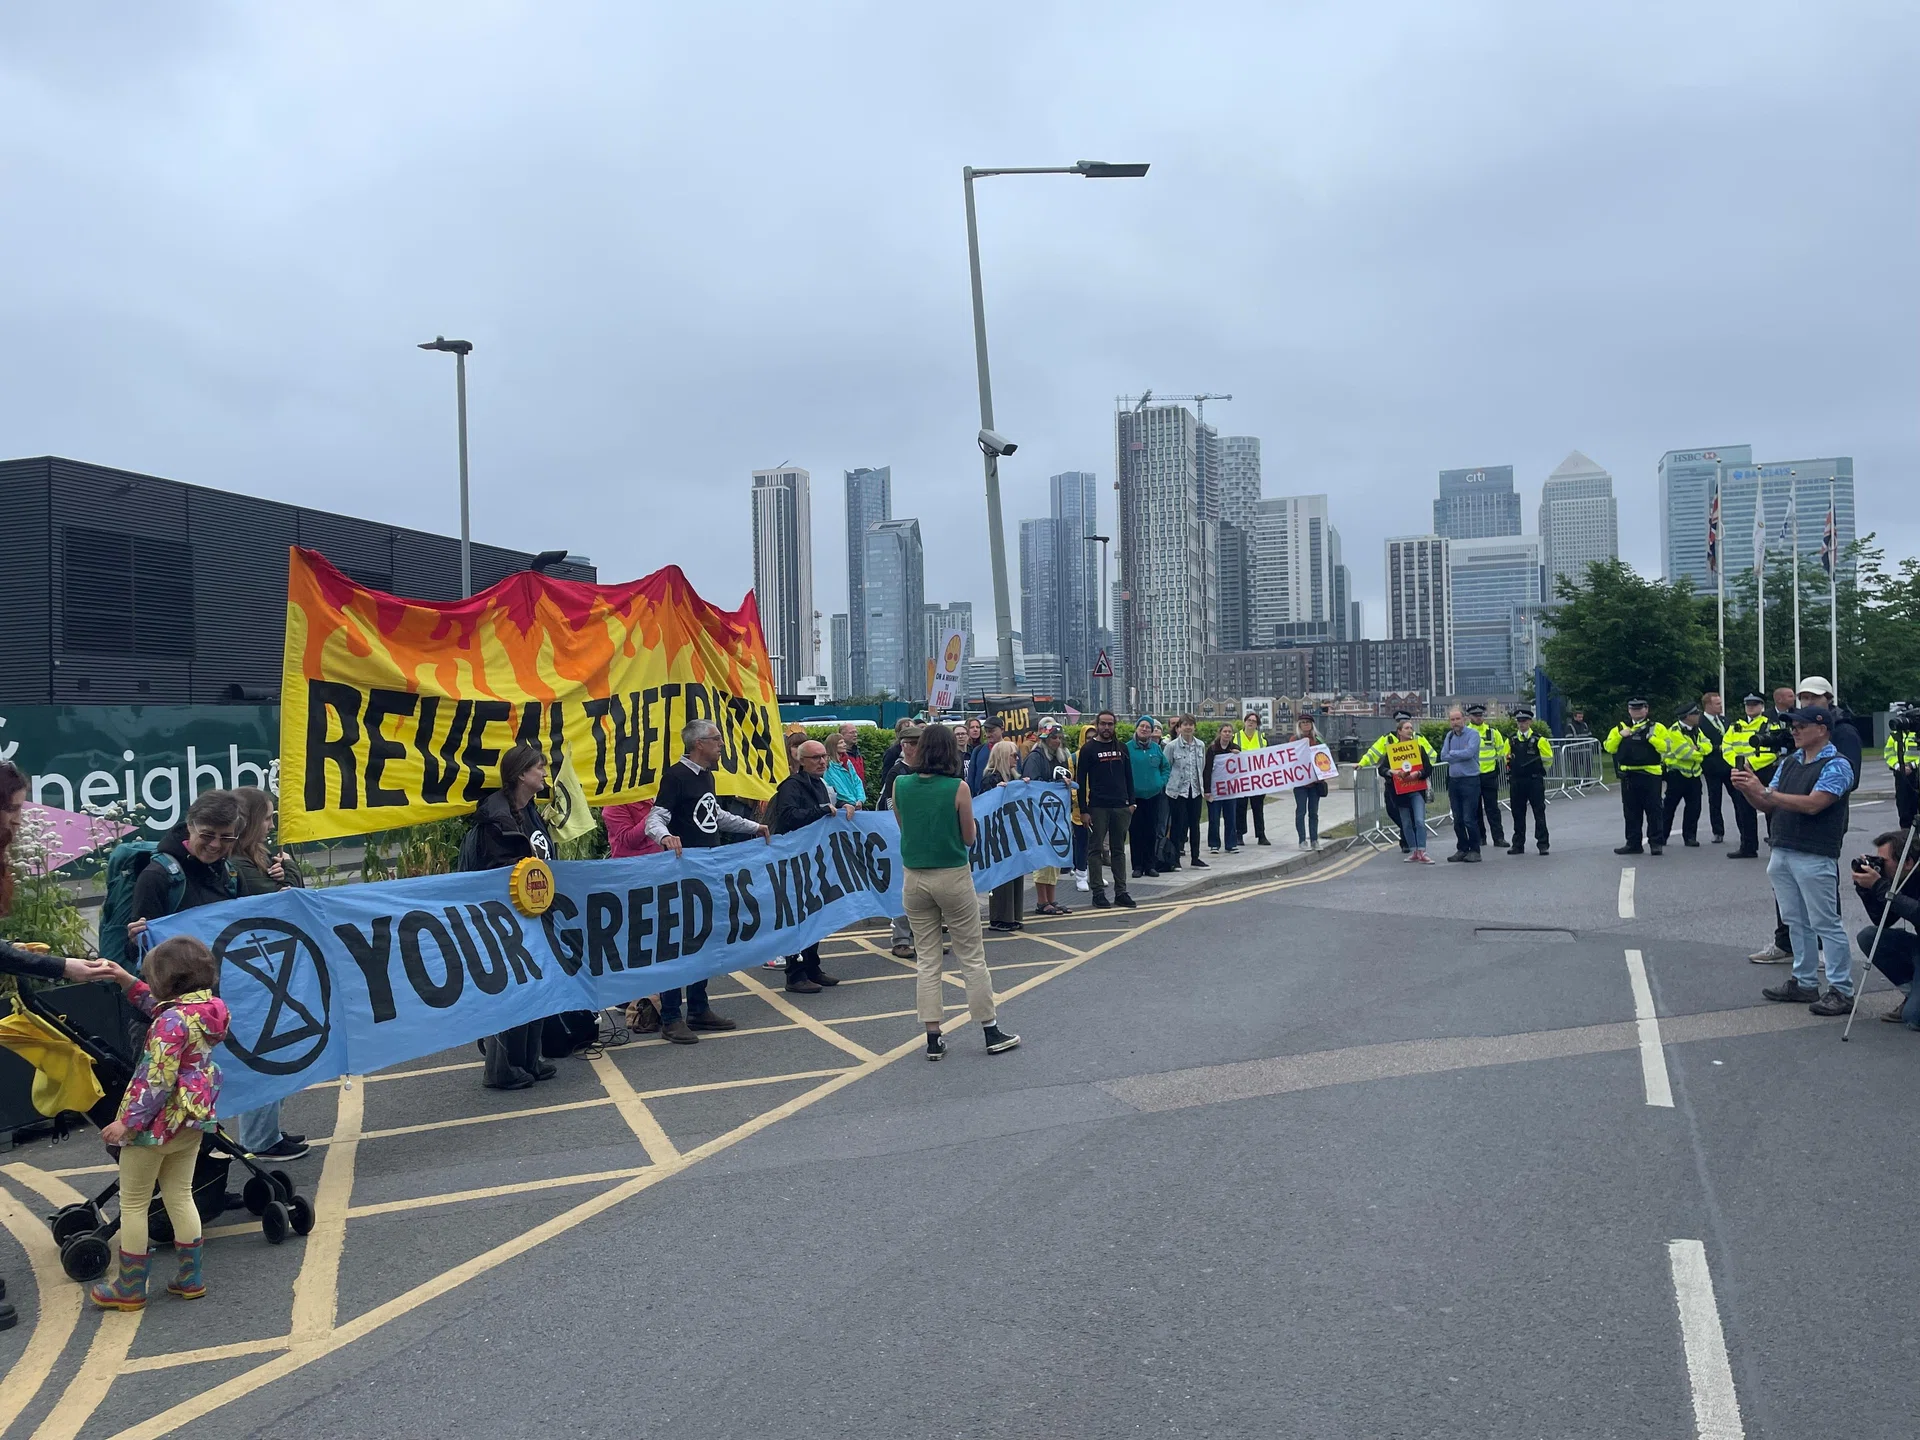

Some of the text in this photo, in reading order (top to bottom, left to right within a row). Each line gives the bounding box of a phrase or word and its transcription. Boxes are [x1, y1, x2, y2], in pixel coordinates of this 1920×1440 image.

[1673, 453, 1702, 463] HSBC
[1465, 471, 1486, 483] citi
[1744, 467, 1791, 479] BACLAYS
[935, 690, 952, 707] HELL
[582, 686, 659, 796] THE
[1225, 747, 1298, 775] CLIMATE
[1215, 762, 1312, 797] EMERGENCY
[333, 798, 1043, 1024] YOUR GREED IS KILLING ANITY
